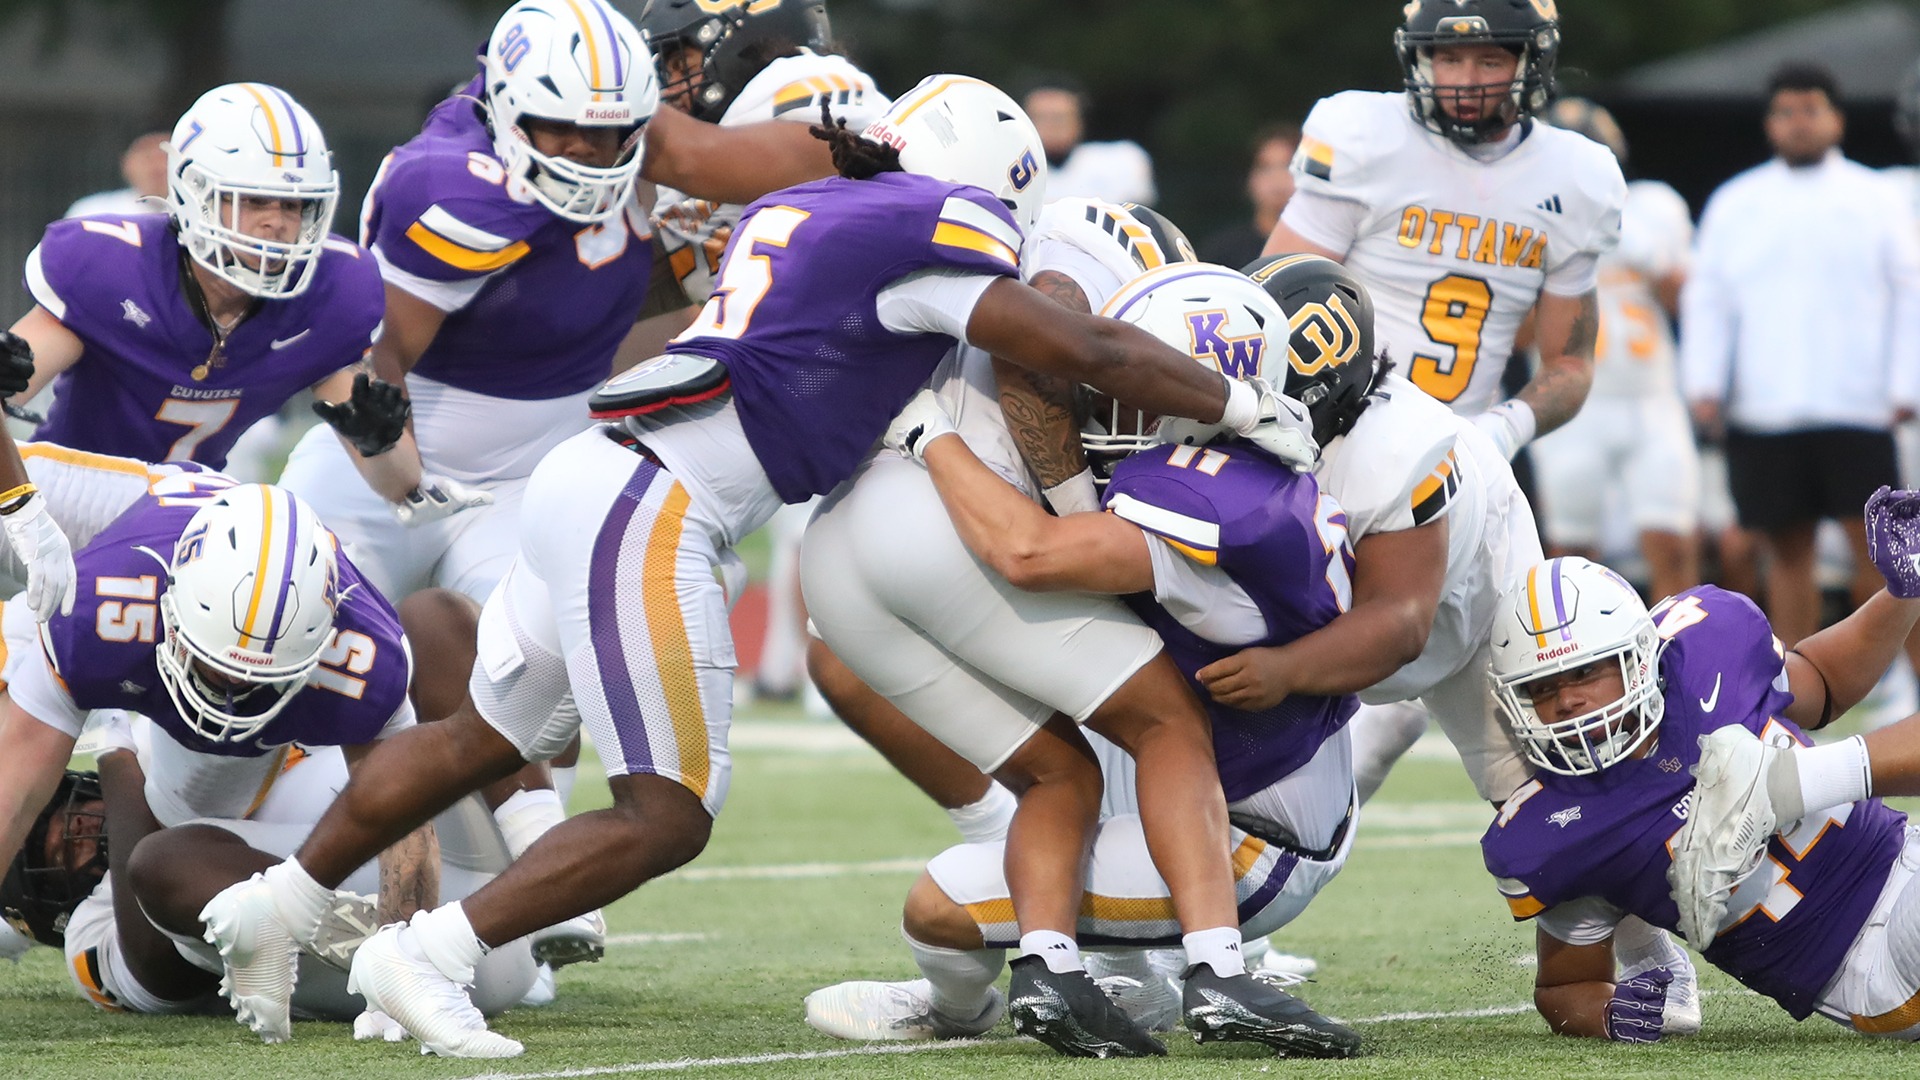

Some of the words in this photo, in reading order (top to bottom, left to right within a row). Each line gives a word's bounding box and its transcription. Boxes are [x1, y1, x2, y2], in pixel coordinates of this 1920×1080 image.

[498, 22, 531, 76] 90
[179, 121, 206, 152] 7
[585, 109, 630, 119] Riddell
[865, 121, 907, 152] ddell
[1007, 146, 1039, 194] 5
[82, 220, 143, 248] 7
[1397, 205, 1548, 268] OTTAWA
[668, 205, 812, 344] 5
[1184, 308, 1268, 382] KW
[1408, 272, 1494, 402] 9
[170, 384, 243, 399] COYOTES
[154, 397, 241, 462] 7
[175, 520, 212, 571] 15
[95, 575, 158, 643] 15
[229, 651, 273, 666] Riddell
[306, 628, 378, 700] 15
[1537, 643, 1579, 663] Riddell
[1657, 756, 1682, 774] KW
